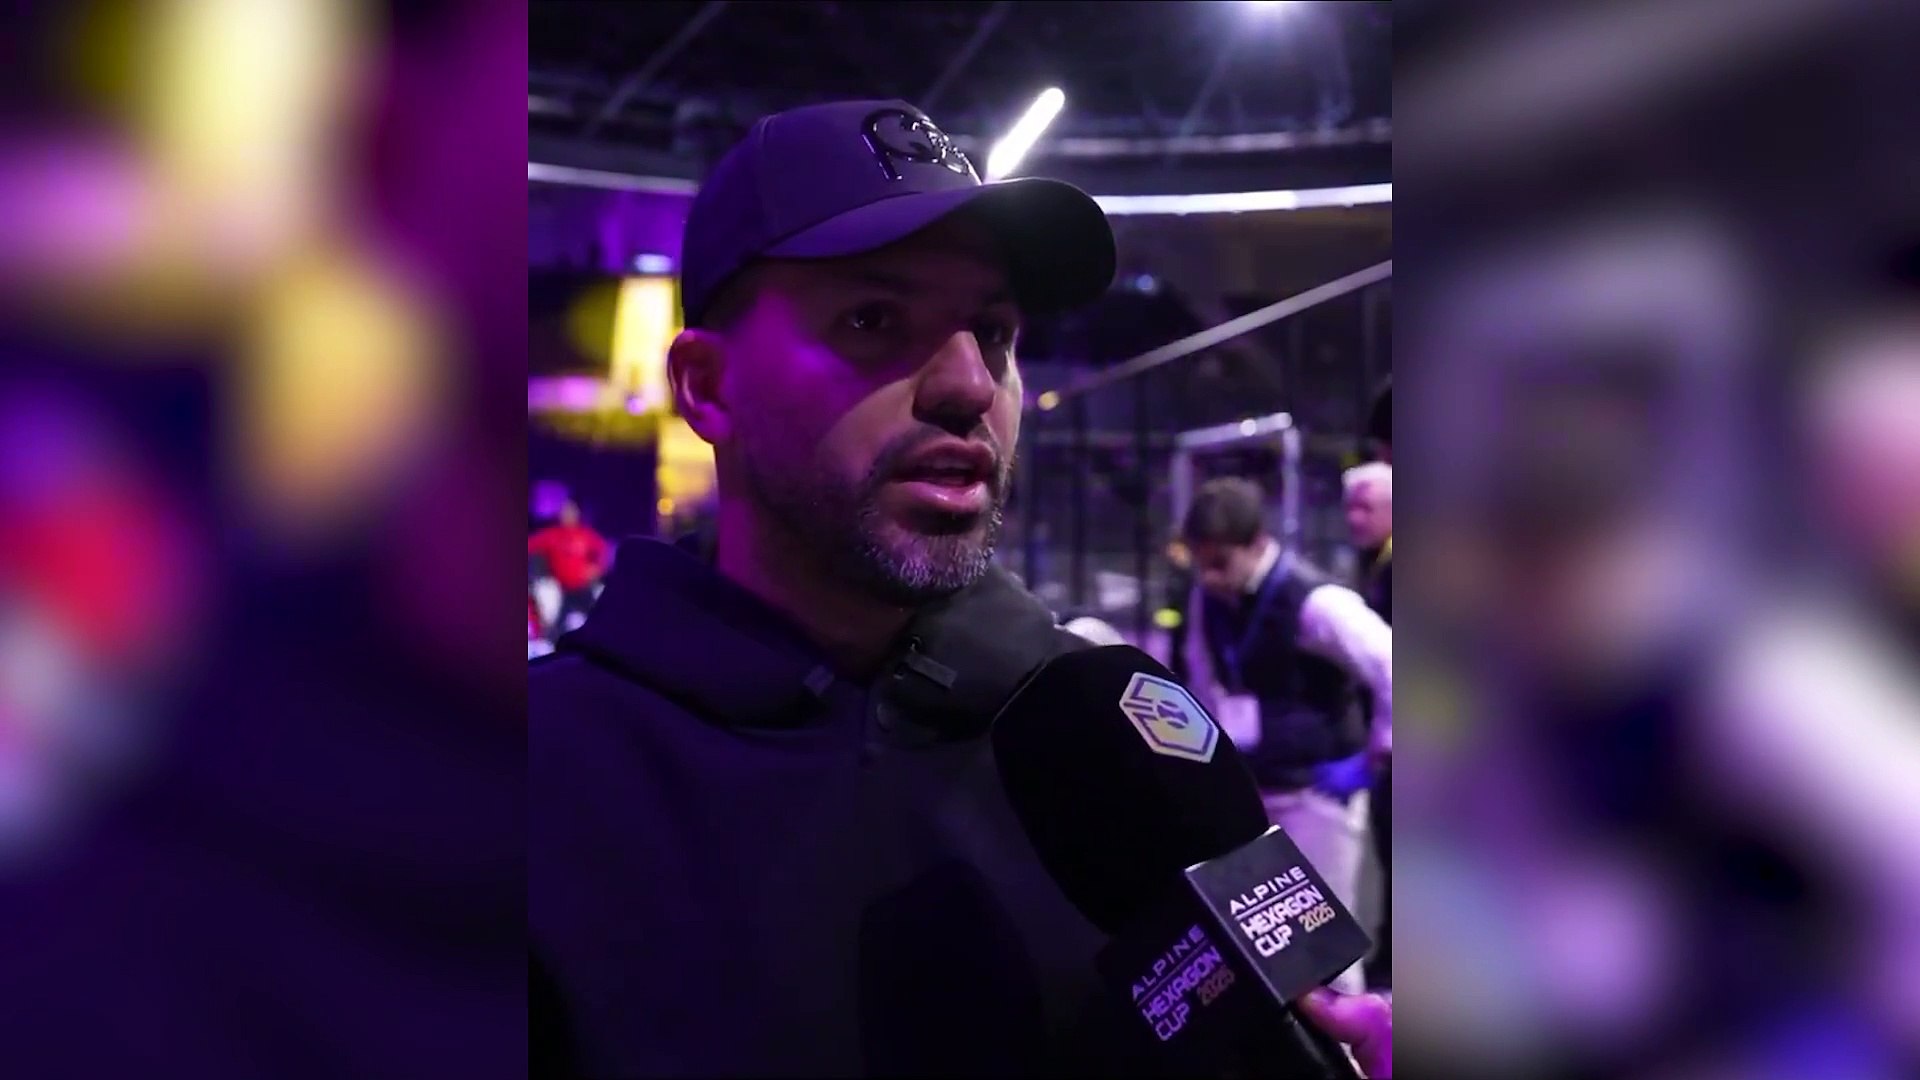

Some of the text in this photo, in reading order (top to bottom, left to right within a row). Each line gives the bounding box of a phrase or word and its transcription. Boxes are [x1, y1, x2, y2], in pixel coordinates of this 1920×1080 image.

[1230, 865, 1307, 916] ALPINE
[1240, 884, 1326, 940] HEXAGON
[1254, 901, 1337, 958] CUP 2025
[1132, 924, 1206, 1002] ALPINE
[1142, 945, 1223, 1026] HEXAGON
[1155, 1002, 1191, 1042] CUP
